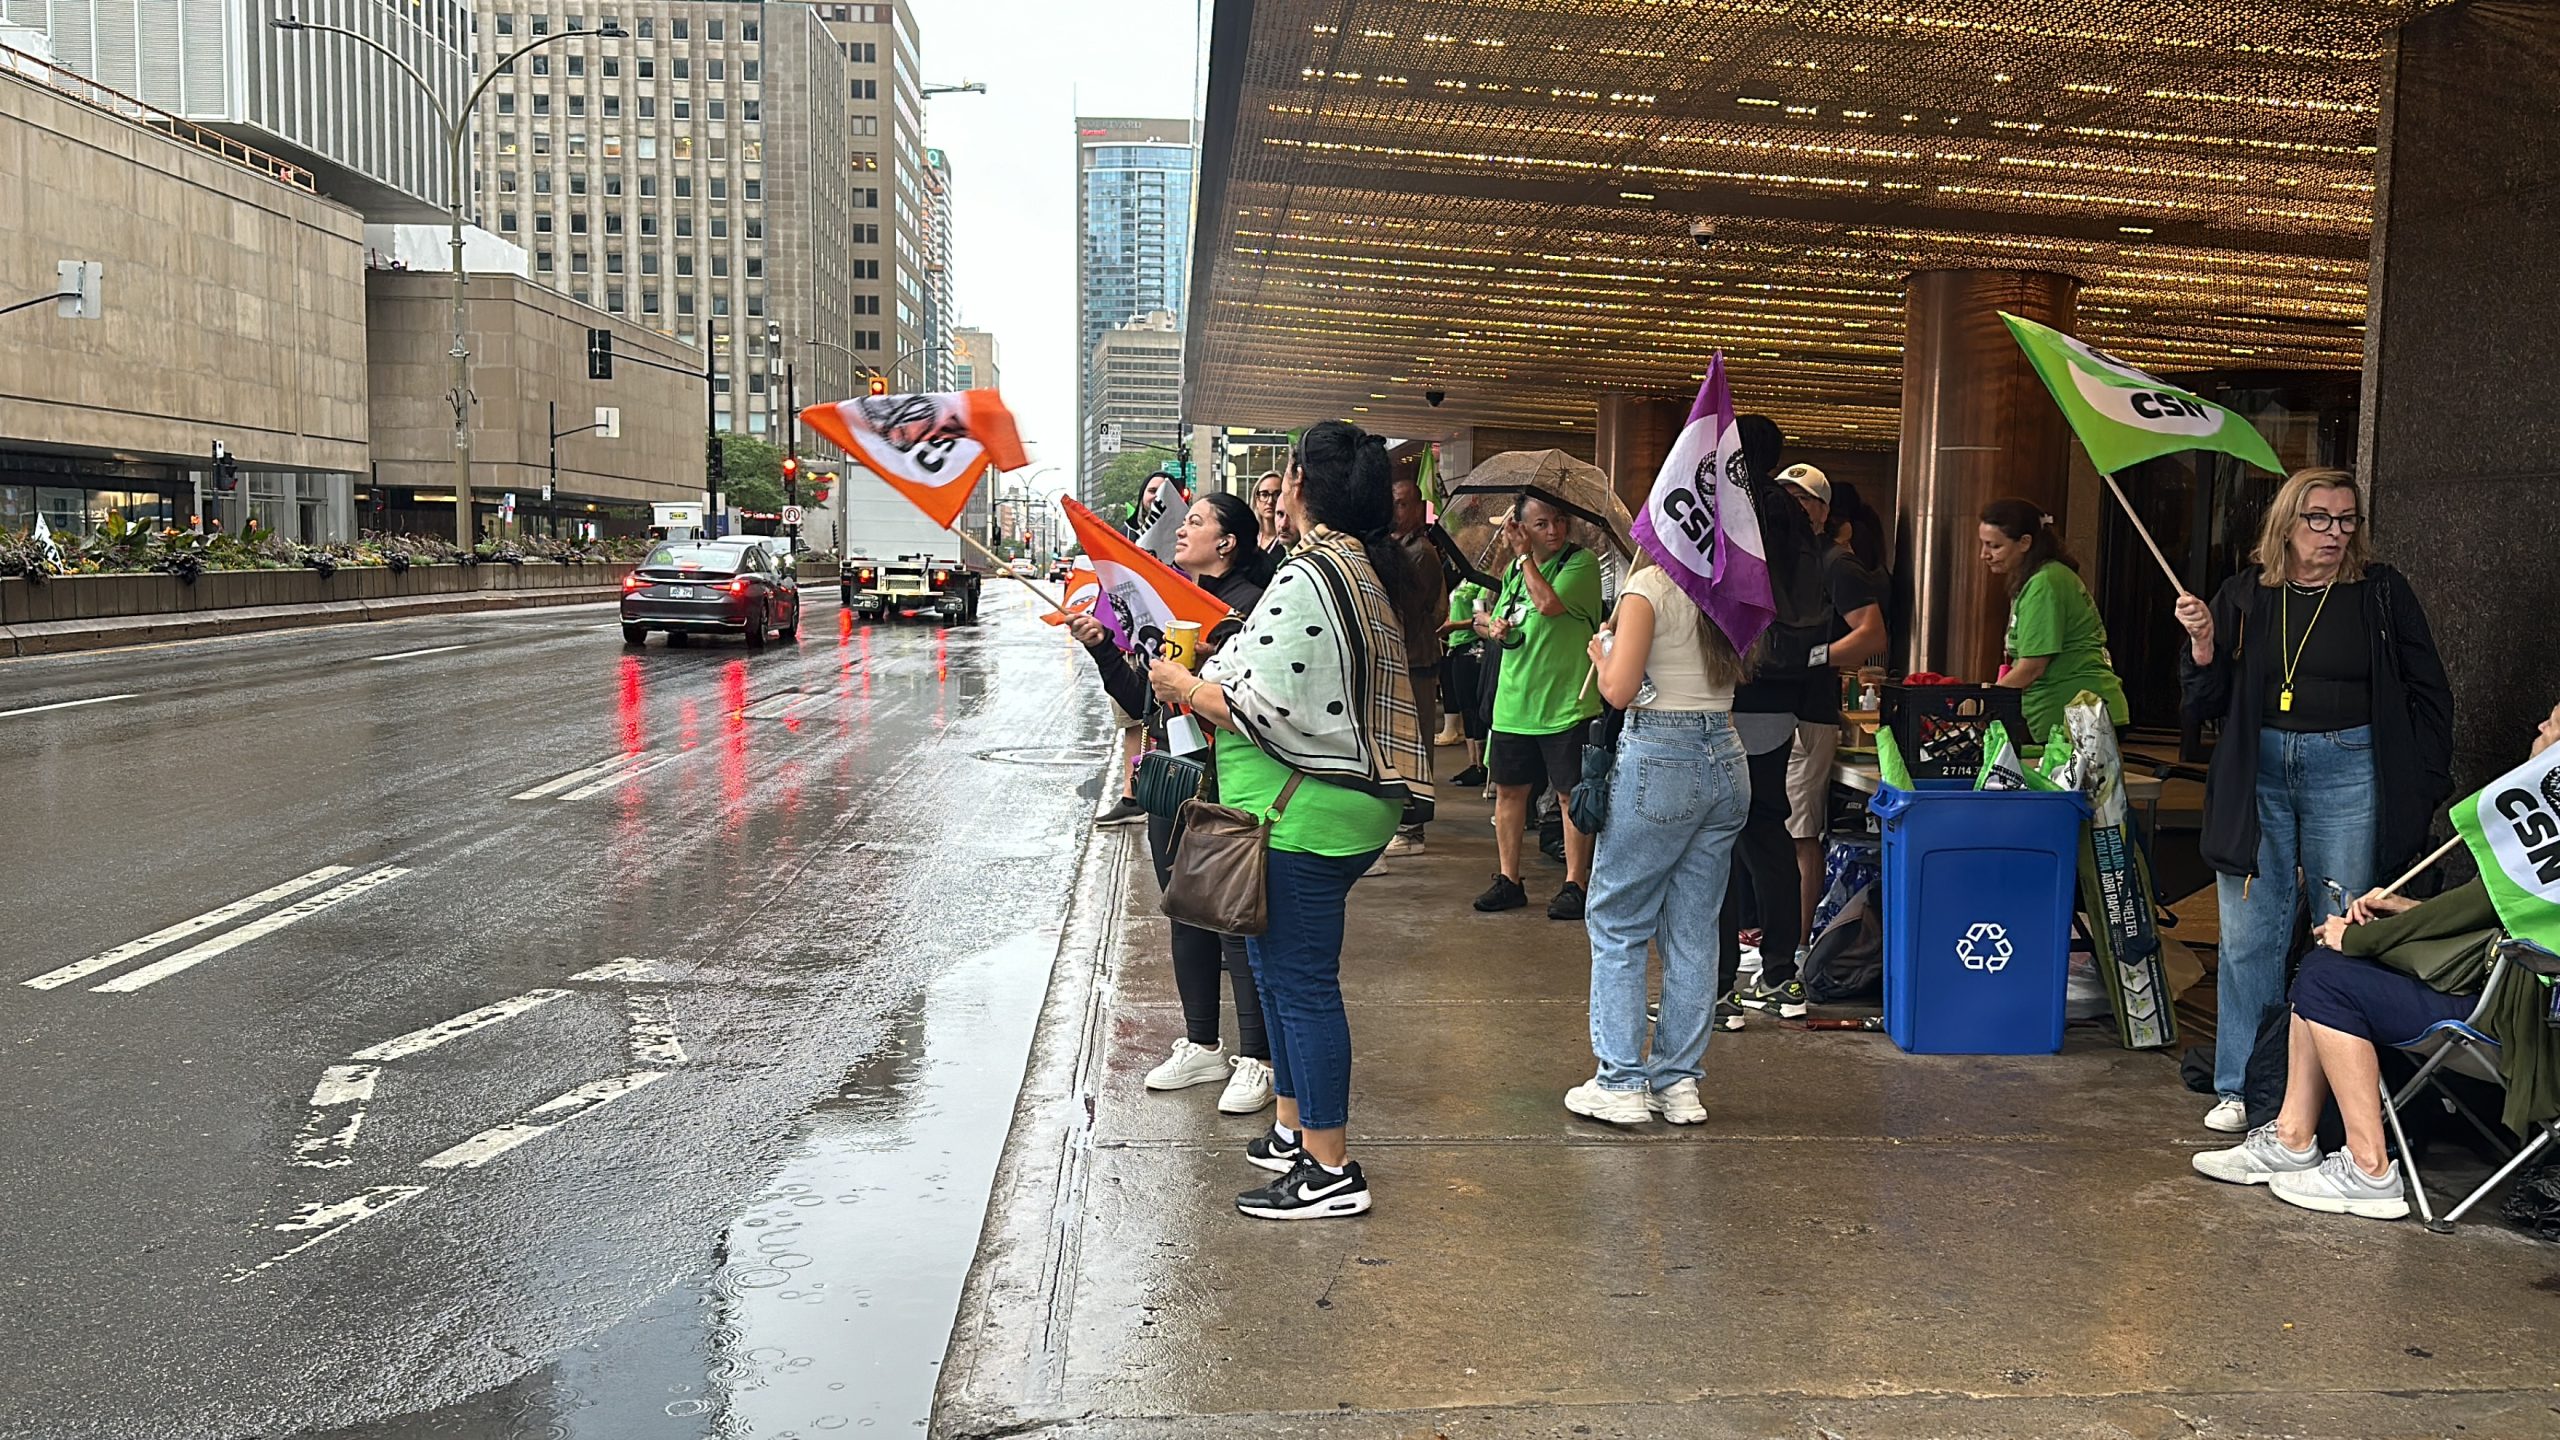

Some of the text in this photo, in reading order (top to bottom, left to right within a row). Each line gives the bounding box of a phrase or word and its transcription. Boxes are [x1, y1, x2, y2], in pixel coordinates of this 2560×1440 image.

[2130, 392, 2210, 422] CSN
[2093, 830, 2112, 871] CATALINA
[2107, 828, 2125, 869] CATALINA
[2495, 788, 2560, 885] CSN
[2101, 872, 2117, 893] ABRI
[2105, 894, 2122, 925] RAPIDE
